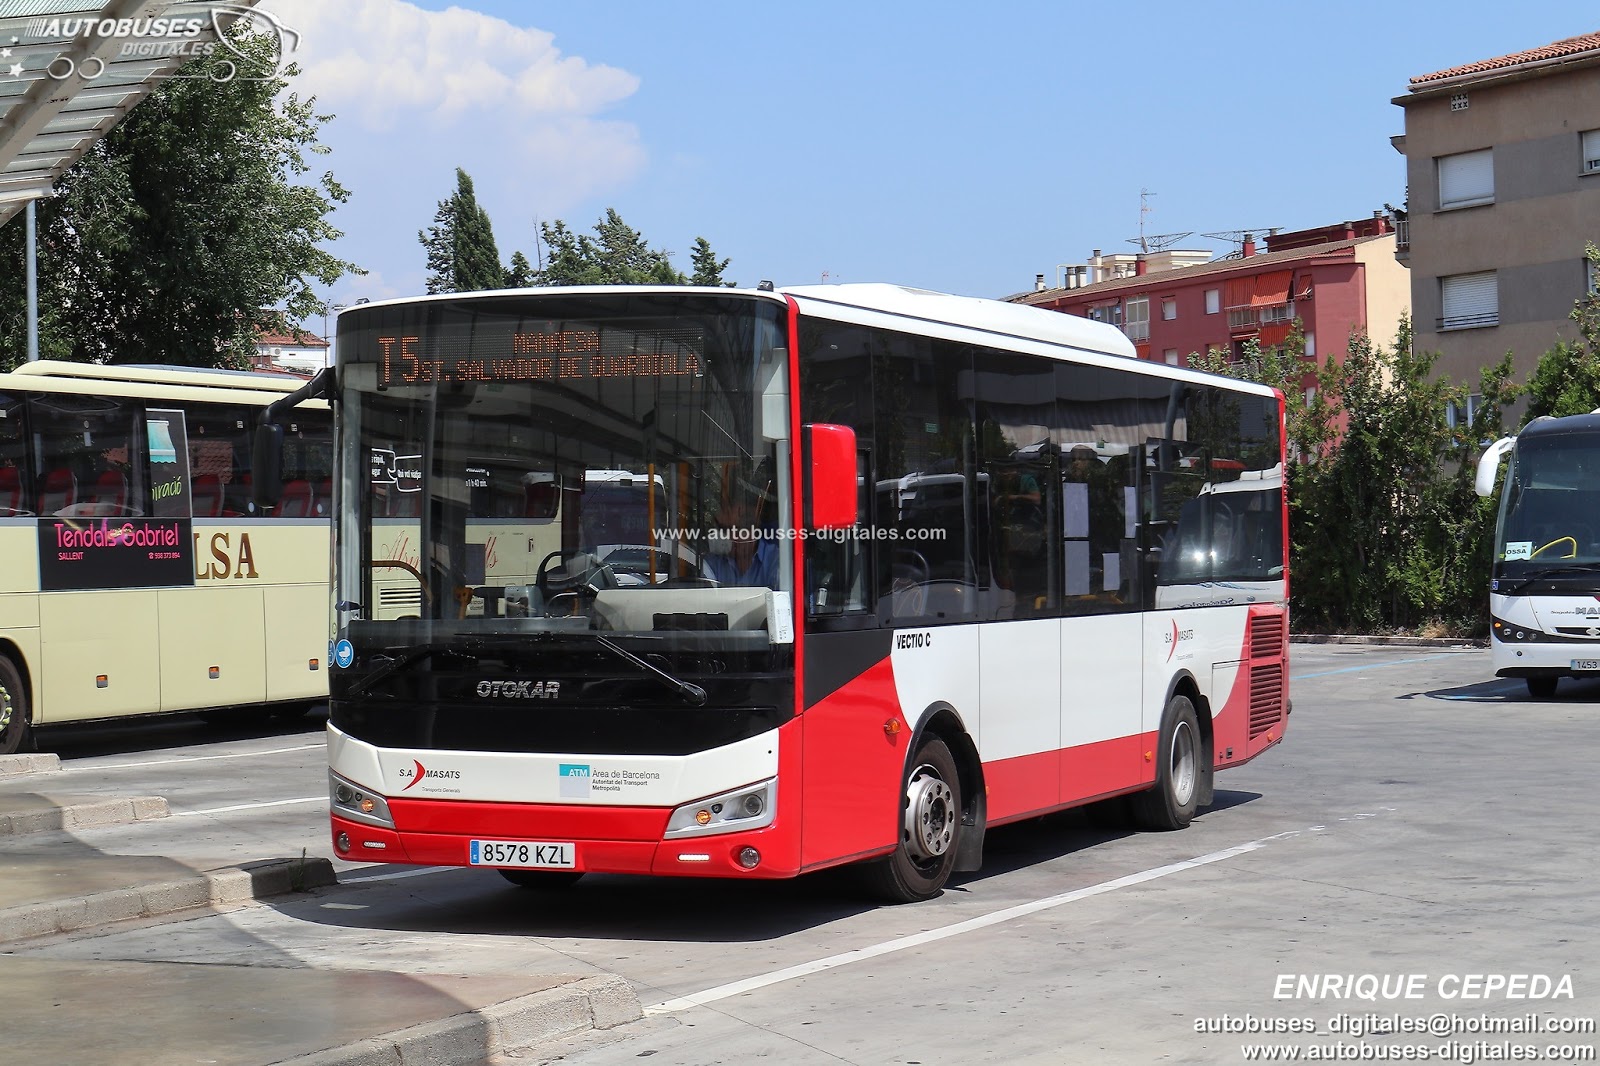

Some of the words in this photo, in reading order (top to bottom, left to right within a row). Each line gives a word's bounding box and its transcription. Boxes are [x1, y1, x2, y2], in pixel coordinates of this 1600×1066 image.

[514, 331, 600, 353] MANRESA
[421, 361, 450, 382] ST.
[456, 358, 552, 381] SALVADOR
[559, 356, 583, 378] DE
[590, 353, 698, 377] GUARDIOLA
[54, 523, 117, 548] Tendals
[121, 523, 179, 547] Gabriel
[58, 552, 84, 560] SALLENT
[1575, 606, 1600, 615] MA
[897, 632, 924, 650] VECTIO
[925, 632, 931, 647] C
[1577, 661, 1598, 669] 1453
[476, 680, 560, 699] OTOKAR
[399, 768, 414, 778] S.A.
[425, 770, 460, 779] MASATS
[568, 768, 589, 777] ATM
[610, 770, 621, 778] de
[622, 770, 660, 780] Barcelona
[624, 779, 648, 787] Transport
[484, 843, 529, 863] 8578
[535, 845, 571, 864] KZL
